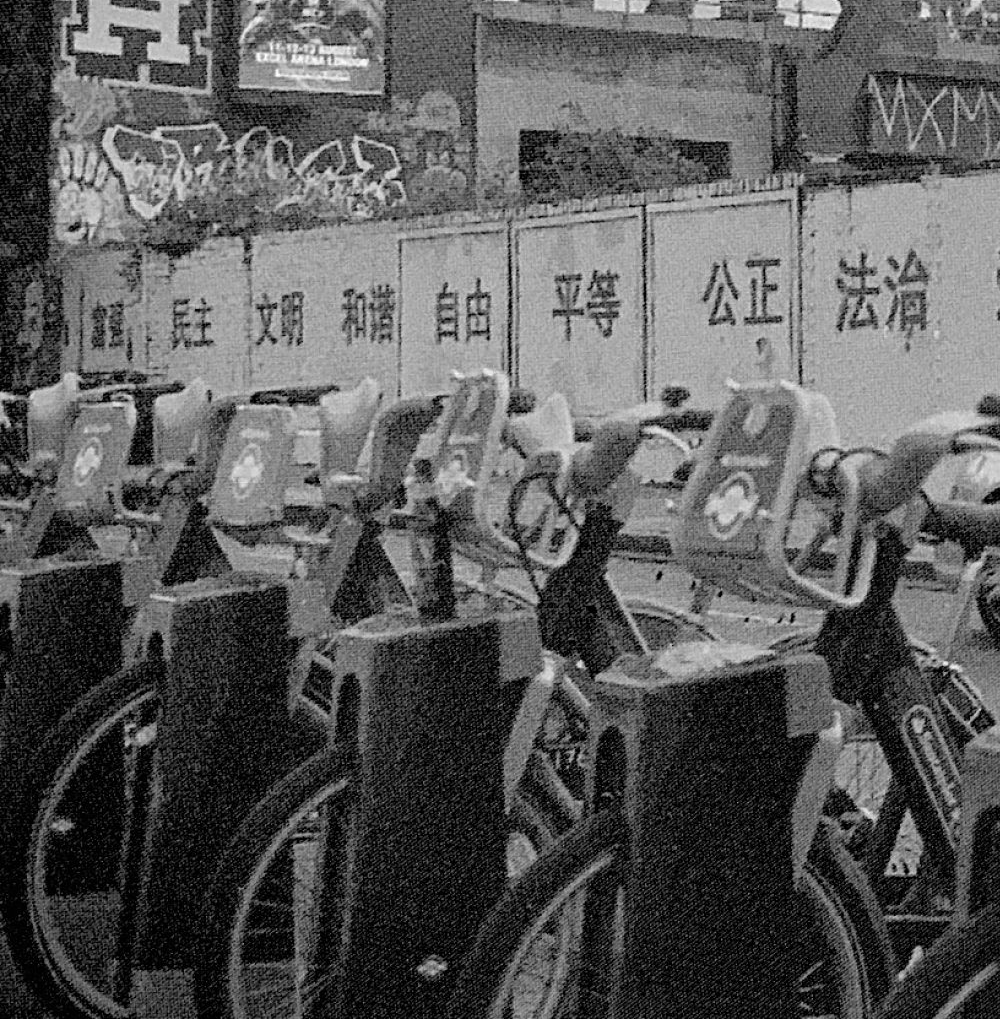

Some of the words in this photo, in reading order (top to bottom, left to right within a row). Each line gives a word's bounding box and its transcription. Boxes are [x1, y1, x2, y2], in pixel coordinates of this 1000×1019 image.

[171, 297, 214, 349] 民主
[255, 291, 304, 347] 文明
[435, 277, 491, 345] 自由
[552, 270, 621, 342] 平等
[703, 259, 783, 326] 公正
[836, 249, 931, 333] 法治
